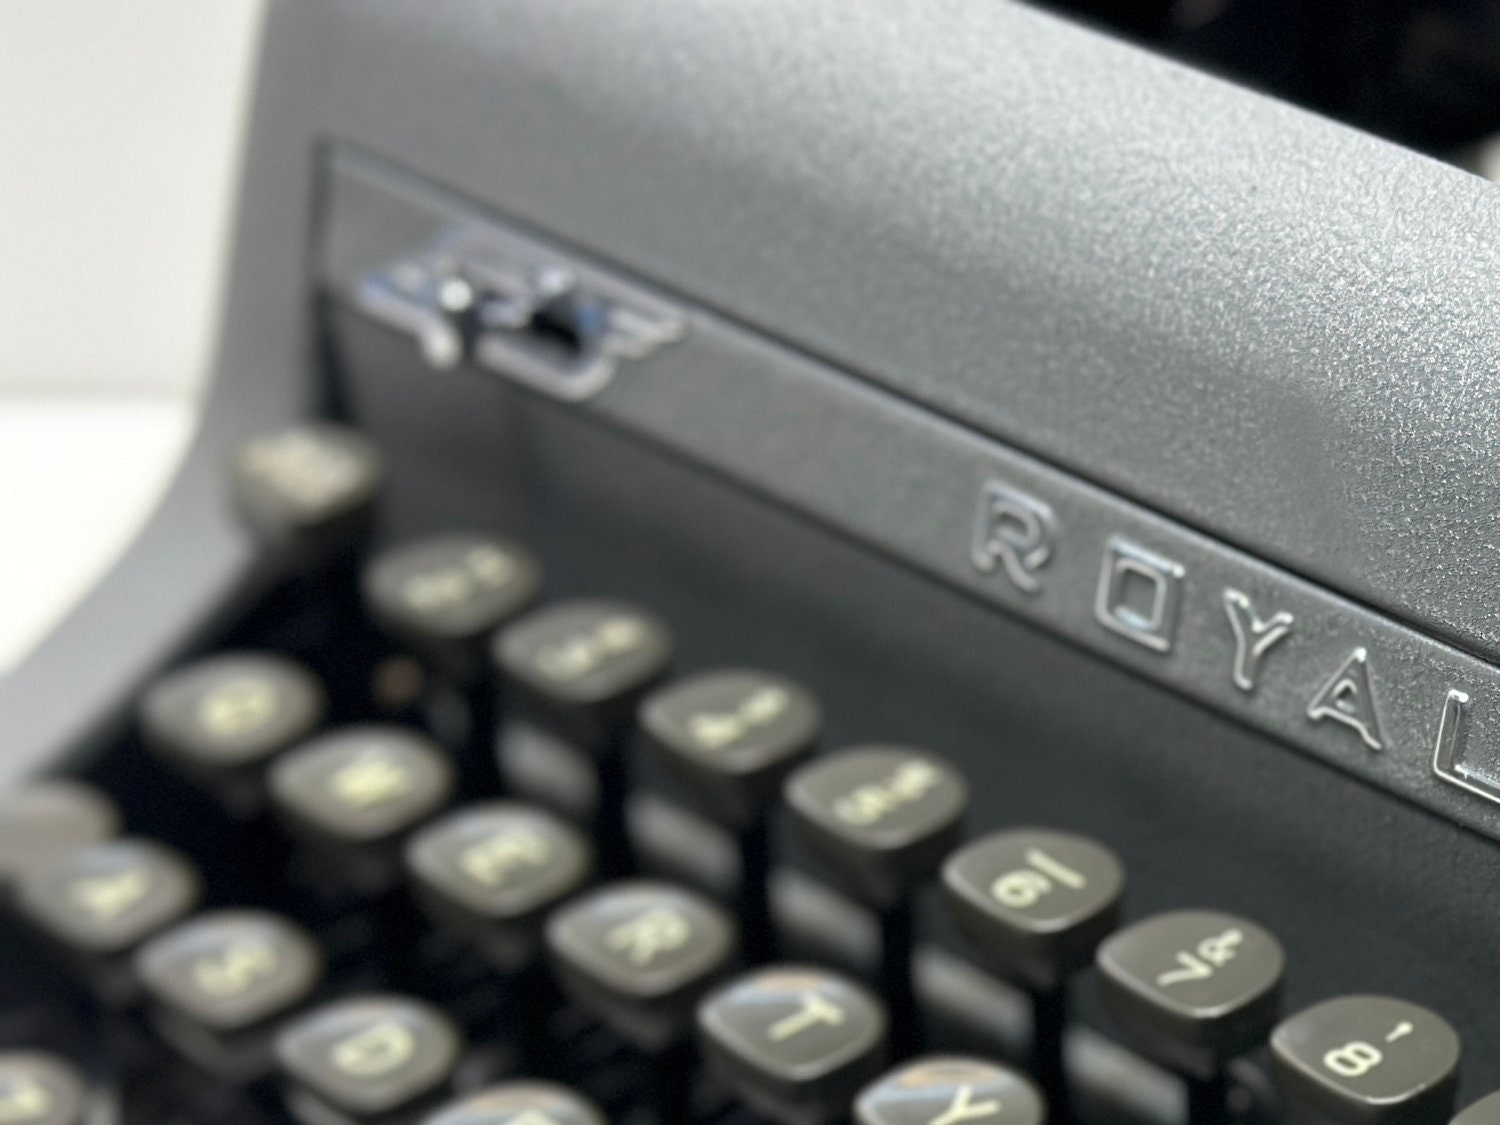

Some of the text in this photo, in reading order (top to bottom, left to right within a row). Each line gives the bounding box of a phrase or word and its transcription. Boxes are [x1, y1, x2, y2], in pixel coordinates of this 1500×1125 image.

[991, 868, 1052, 909] 6
[1156, 950, 1215, 987] 7
[767, 984, 846, 1041] T
[1323, 1040, 1383, 1077] 8
